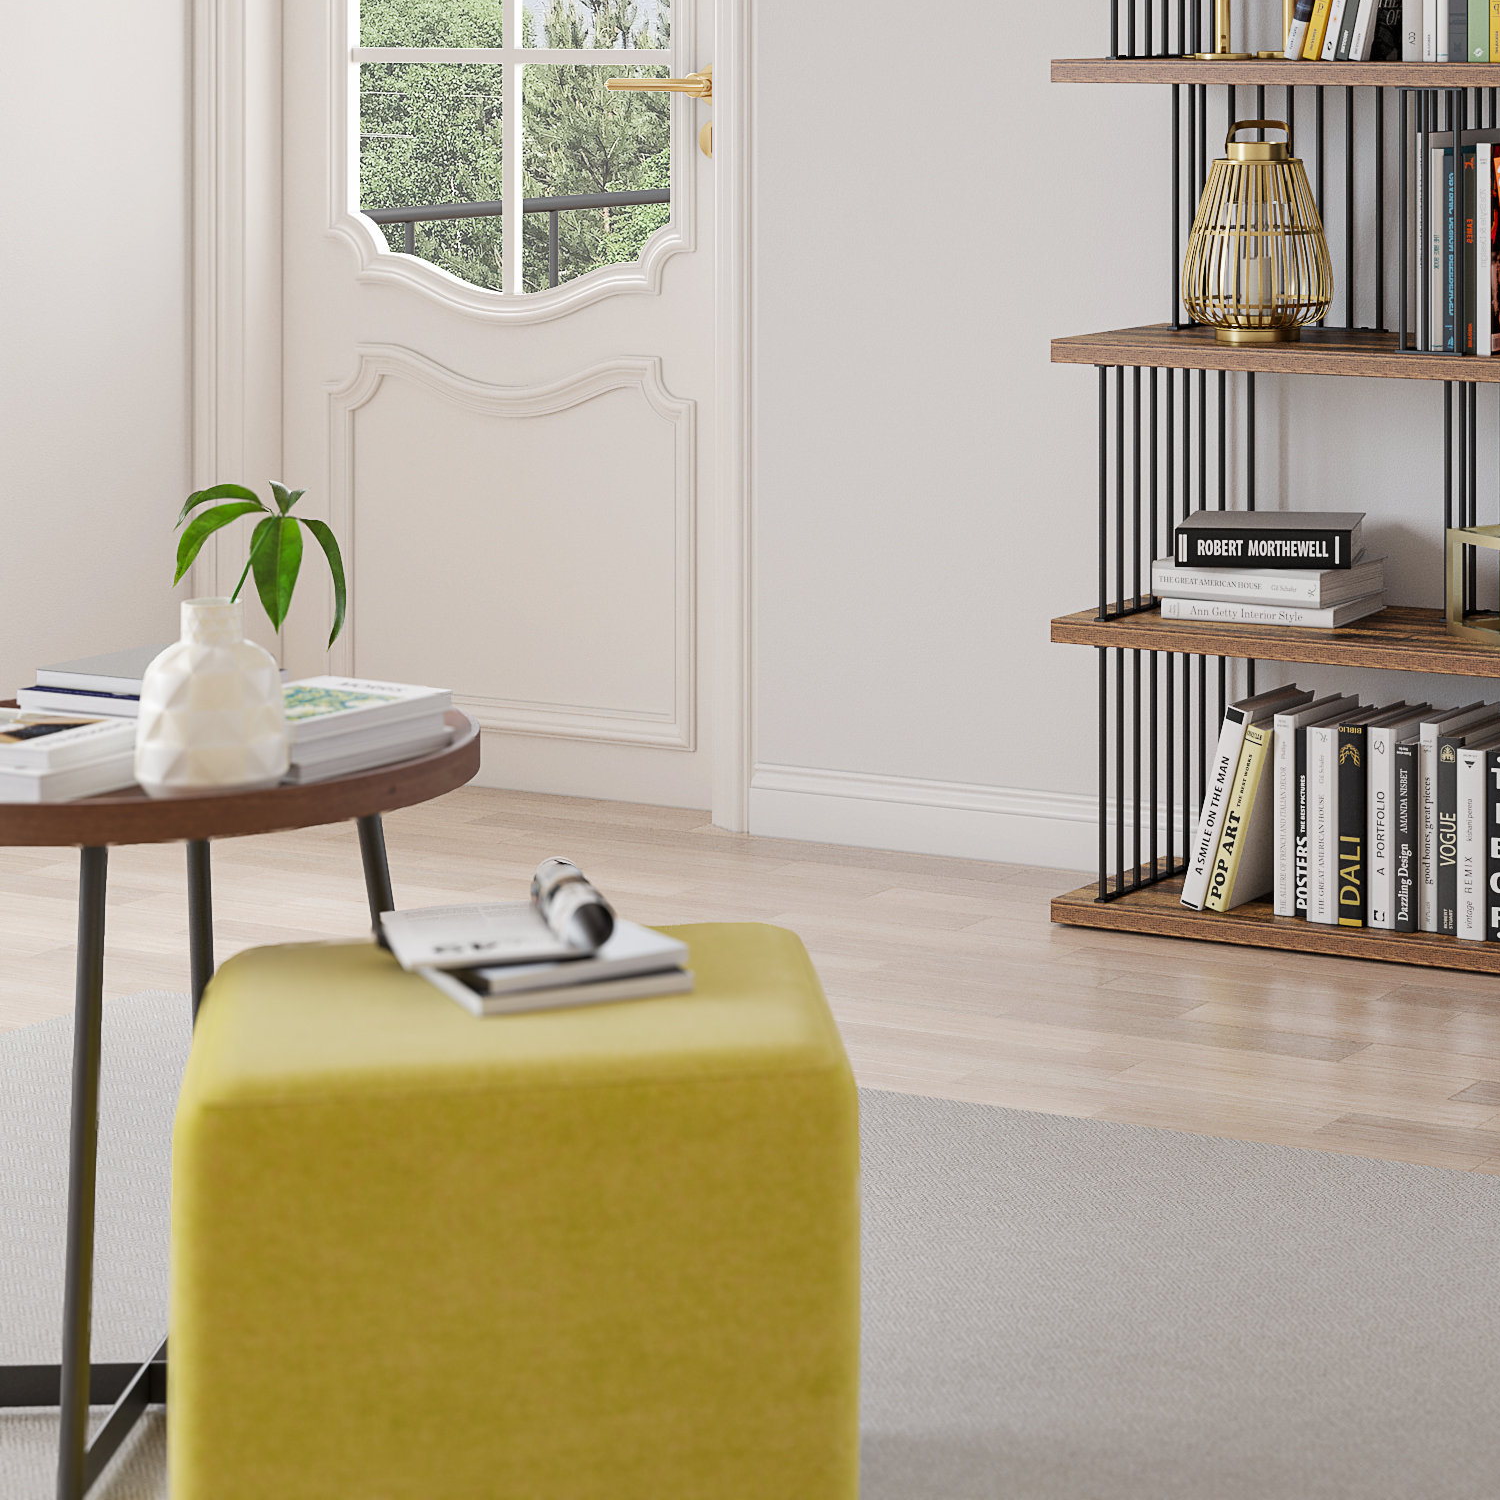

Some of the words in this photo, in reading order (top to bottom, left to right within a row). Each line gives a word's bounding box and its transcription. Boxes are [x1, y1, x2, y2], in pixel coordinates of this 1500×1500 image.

[1197, 539, 1243, 556] ROBERT
[1248, 540, 1329, 558] MORTHEWELL
[1159, 576, 1175, 584] THE
[1175, 576, 1198, 586] GREAT
[1199, 578, 1238, 588] AMERICAN
[1238, 580, 1263, 590] HOUSE
[1189, 606, 1209, 616] Ann
[1212, 607, 1238, 620] Getty
[1241, 609, 1275, 620] Interior
[1278, 610, 1303, 623] Style
[1338, 726, 1362, 735] BIBLIO
[1217, 756, 1230, 784] MAN
[1244, 754, 1253, 776] WORKS
[1210, 788, 1223, 808] THE
[1239, 777, 1248, 794] BEST
[1399, 768, 1408, 802] NISBET
[1424, 776, 1434, 804] pieces
[1236, 794, 1244, 807] THE
[1206, 810, 1217, 828] ON
[1376, 791, 1385, 859] PORTFOLIO
[1399, 802, 1408, 834] AMANDA
[1424, 805, 1434, 829] great
[1198, 829, 1213, 865] SMILE
[1222, 811, 1241, 856] ART
[1424, 830, 1433, 860] bones,
[1439, 811, 1457, 867] VOGUE
[1195, 867, 1203, 875] A
[1339, 835, 1361, 906] DALI
[1377, 867, 1385, 876] A
[1398, 843, 1412, 873] Design
[1211, 859, 1229, 900] POP
[1296, 836, 1308, 909] POSTERS
[1424, 861, 1434, 885] good
[1465, 856, 1473, 894] REMIX
[1398, 874, 1412, 922] Dazzling
[1466, 900, 1475, 929] vintage
